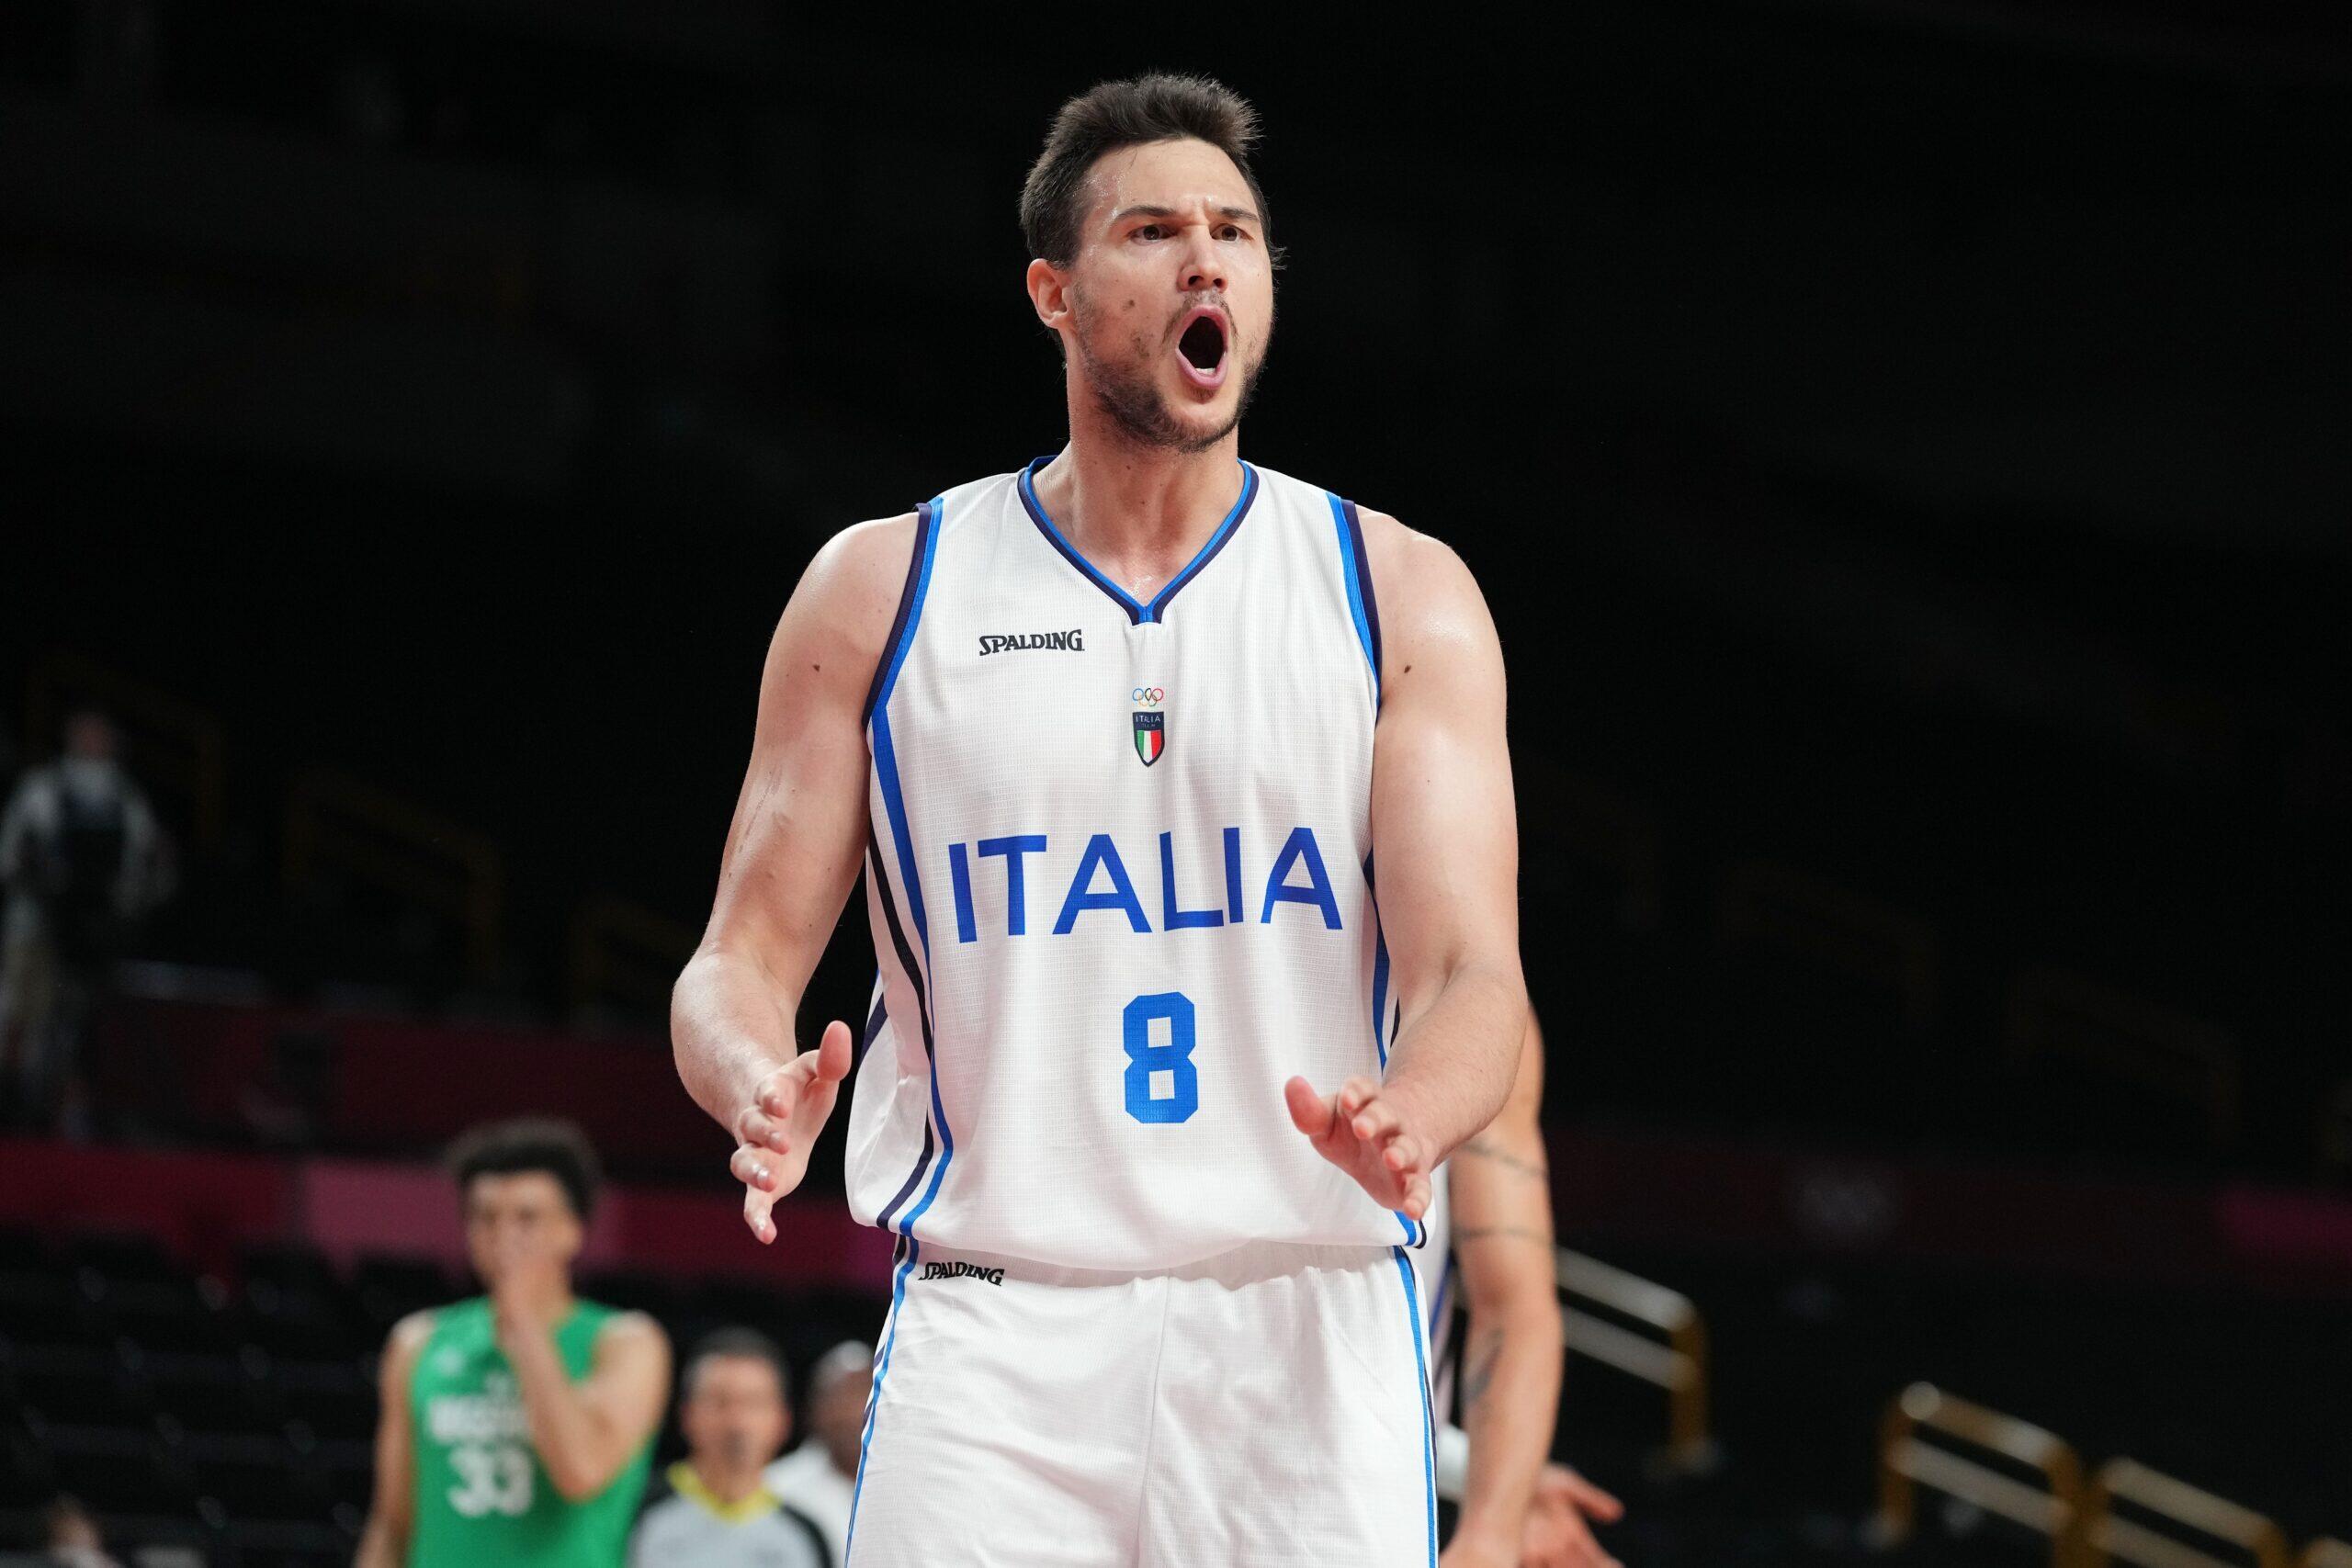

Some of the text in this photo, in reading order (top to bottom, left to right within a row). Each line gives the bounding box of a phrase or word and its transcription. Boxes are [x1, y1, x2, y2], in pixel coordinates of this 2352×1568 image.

[979, 629, 1083, 656] SPALDING
[1136, 715, 1161, 723] ITALIA
[948, 827, 1343, 943] ITALIA
[1123, 991, 1199, 1124] 8
[918, 1261, 1005, 1286] SPALDING
